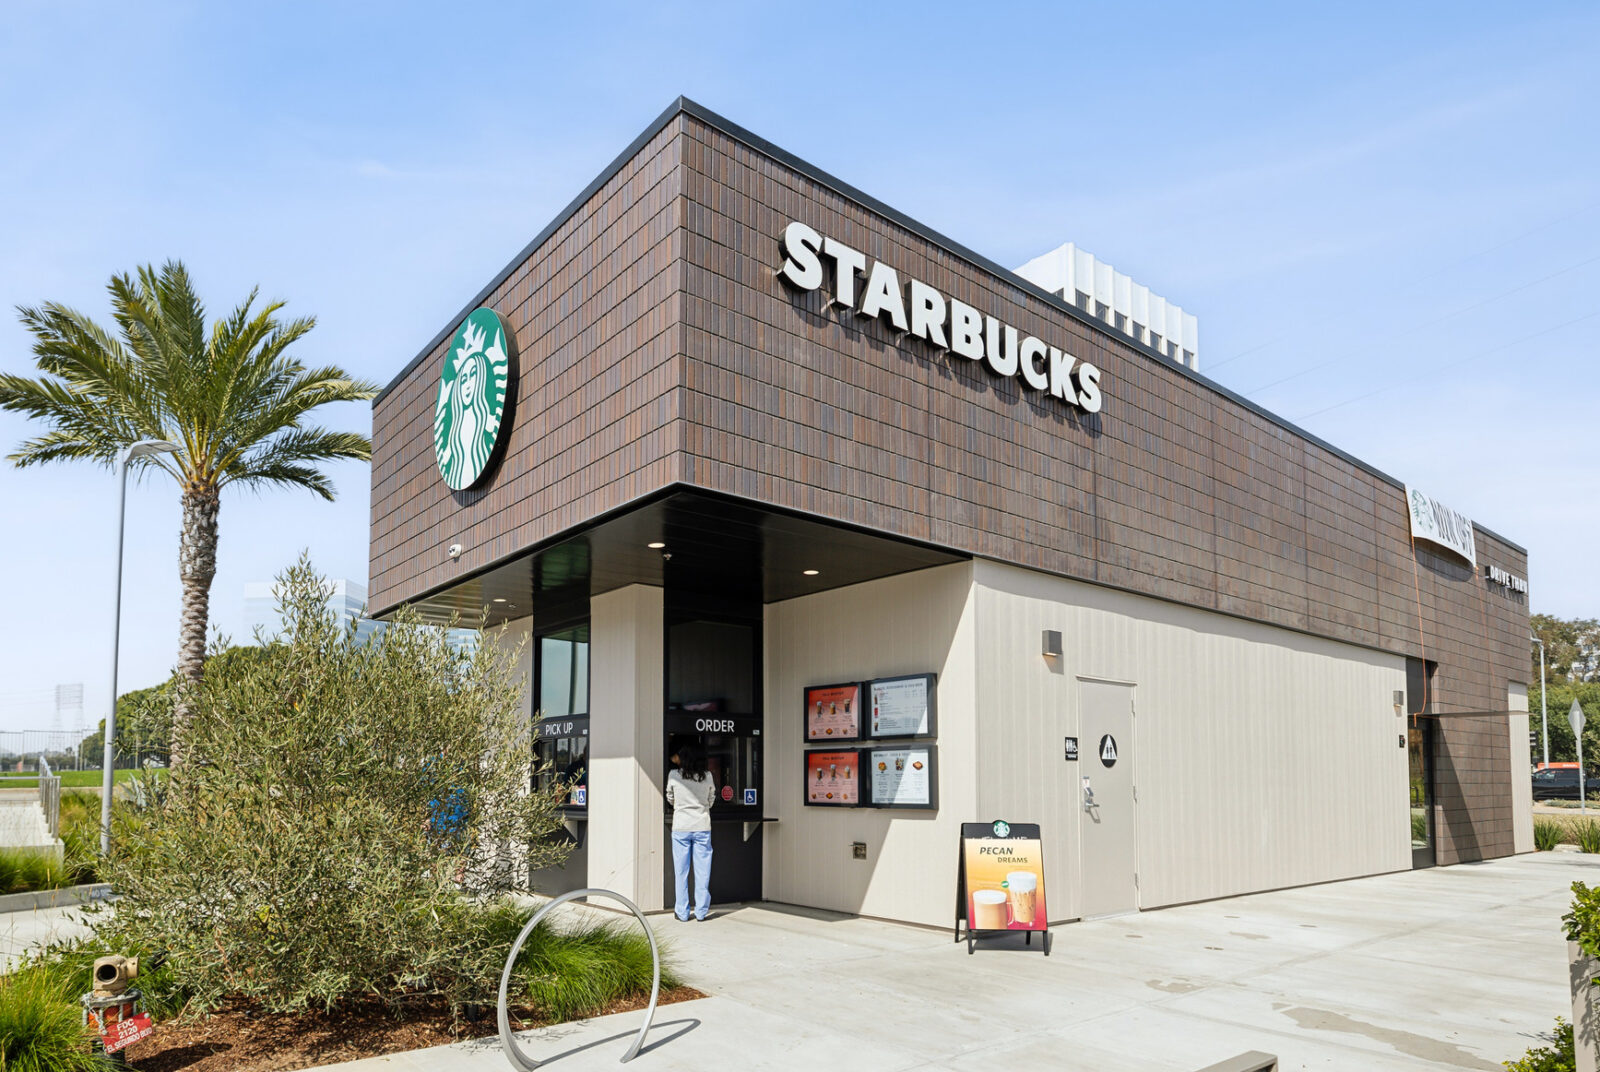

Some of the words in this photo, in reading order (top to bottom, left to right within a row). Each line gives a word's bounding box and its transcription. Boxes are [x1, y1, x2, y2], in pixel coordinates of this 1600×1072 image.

[776, 221, 1102, 414] STARBUCKS
[1489, 564, 1510, 586] DRIVE
[545, 723, 561, 736] PICK
[563, 722, 573, 734] UP
[695, 718, 735, 733] ORDER
[979, 846, 1014, 855] PECAN
[997, 856, 1028, 864] DREAMS
[116, 1018, 135, 1031] FDC
[118, 1025, 138, 1039] 2120
